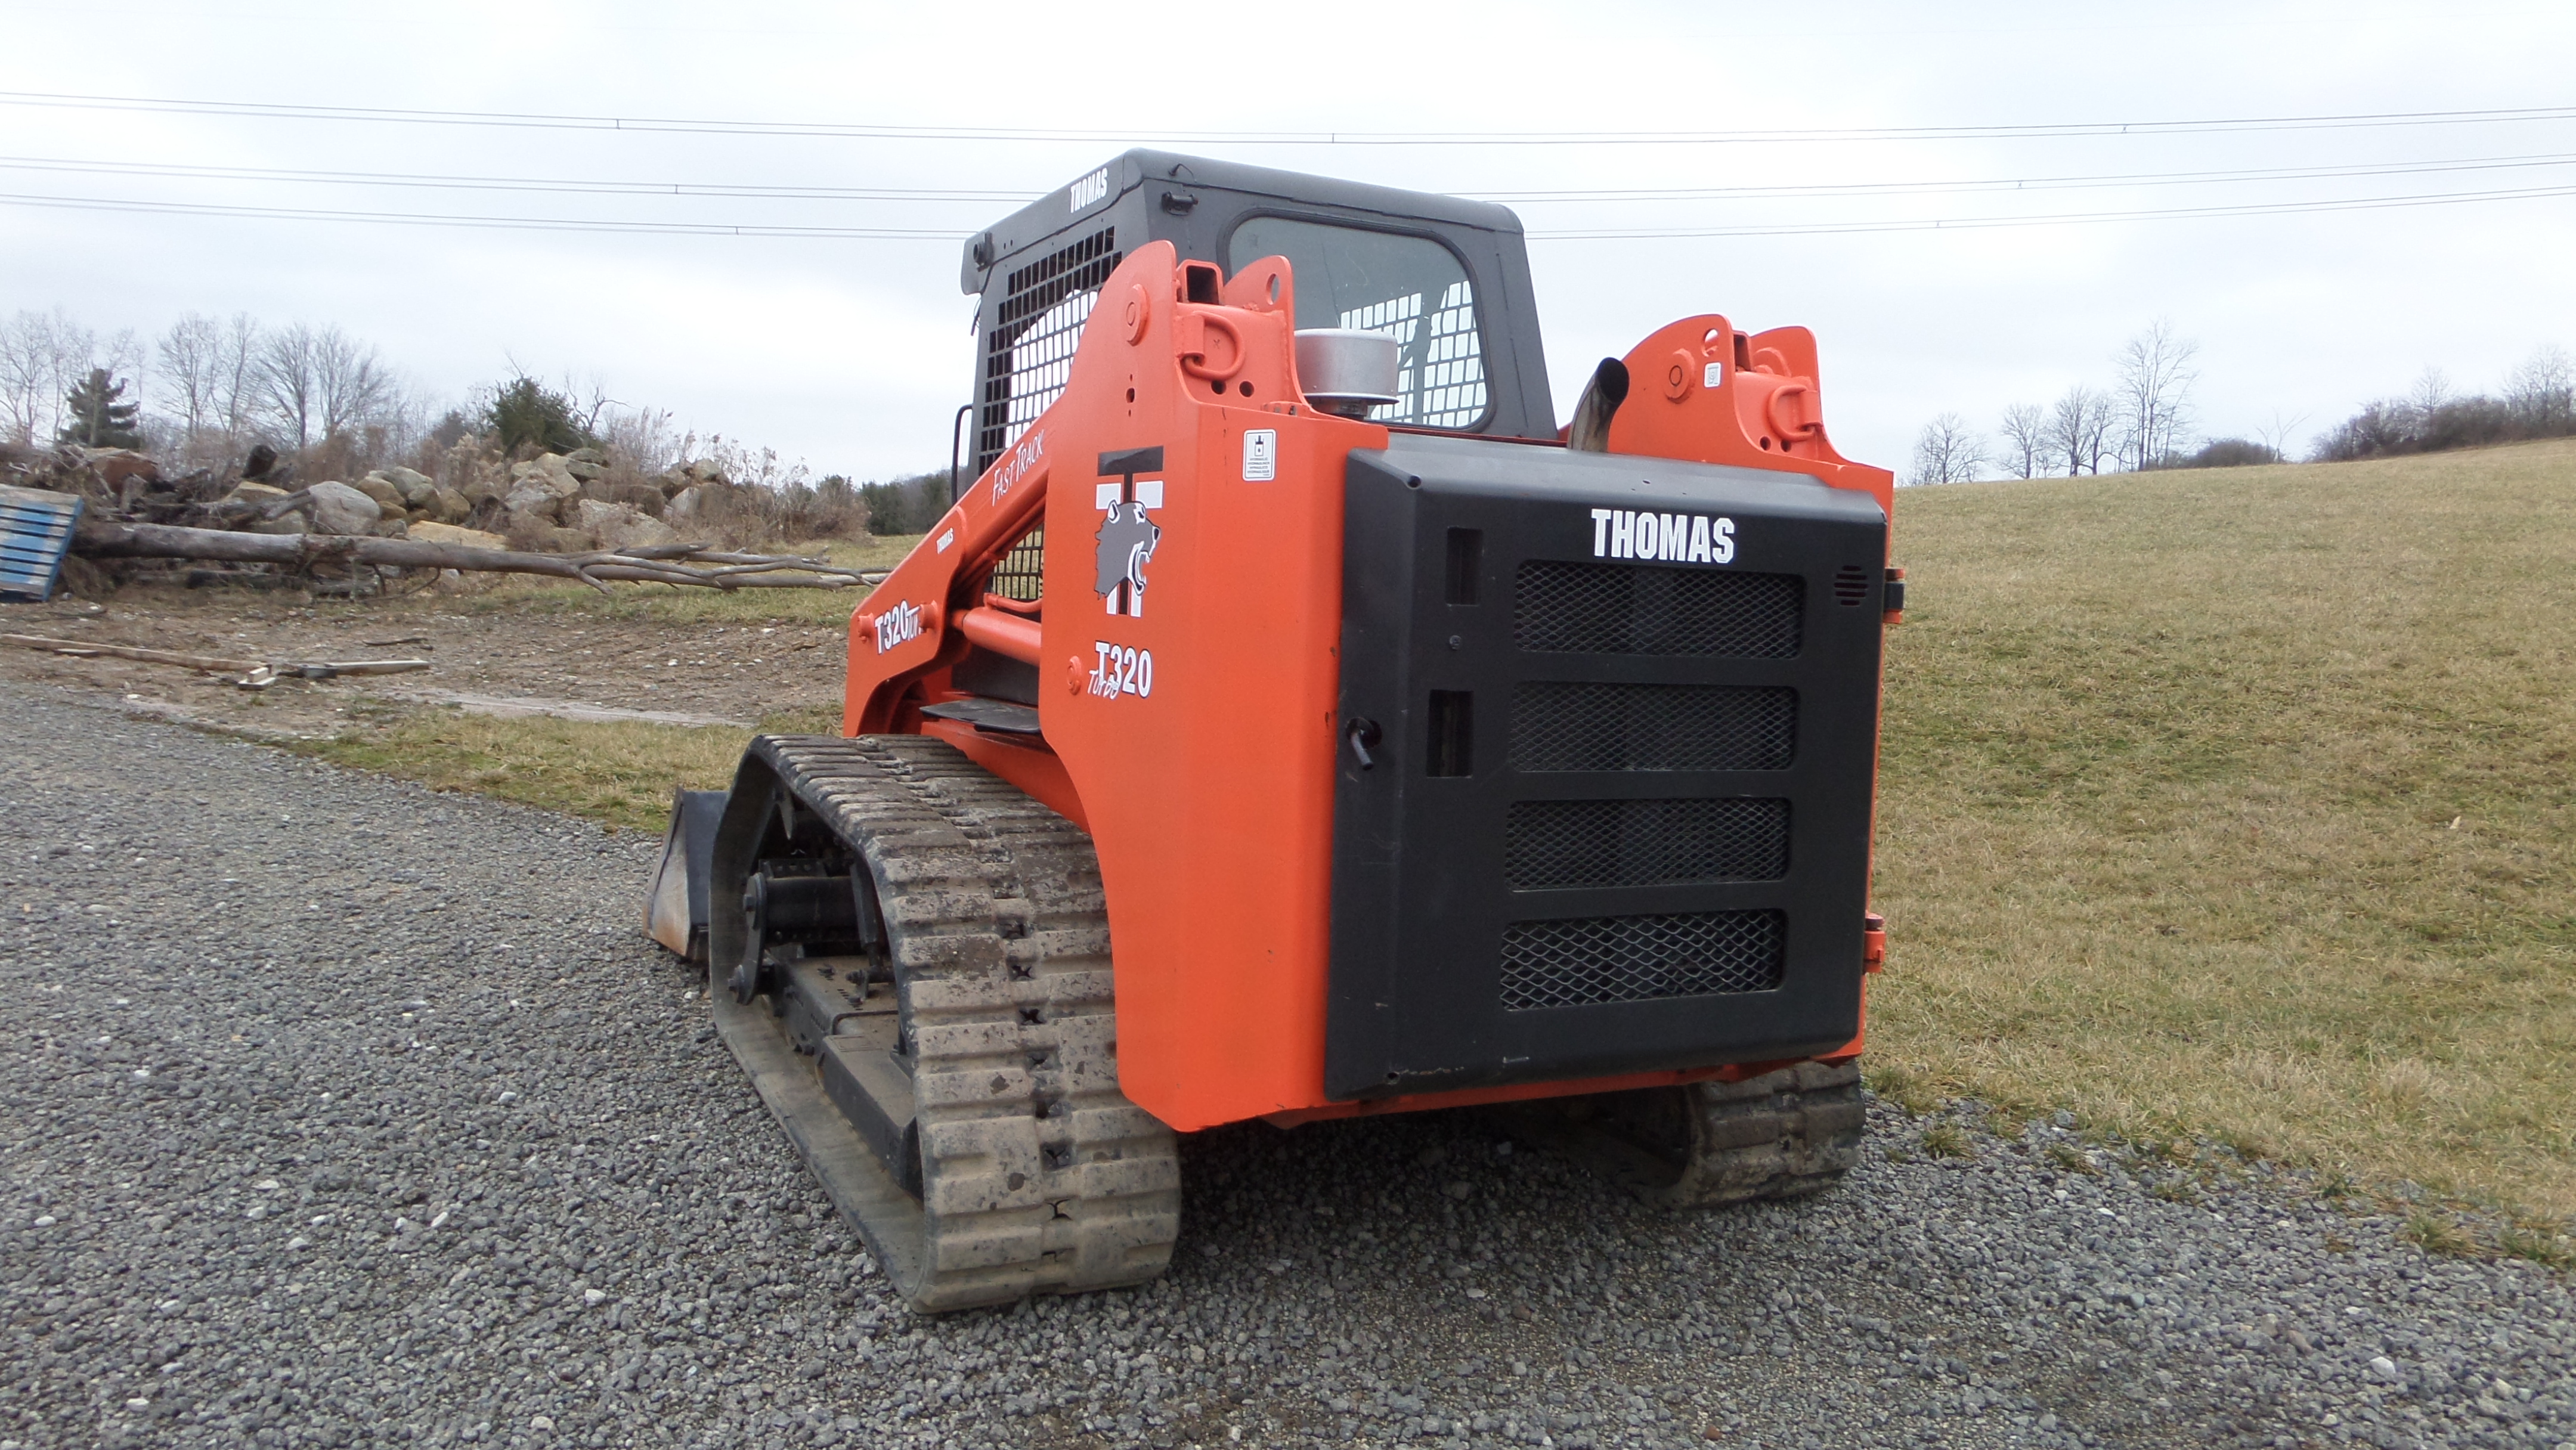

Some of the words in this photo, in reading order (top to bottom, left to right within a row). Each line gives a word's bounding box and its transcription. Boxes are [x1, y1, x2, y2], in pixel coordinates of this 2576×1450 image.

[1070, 168, 1108, 213] THOMAS
[992, 460, 1015, 507] FAST
[1016, 429, 1044, 482] TRACK
[1590, 508, 1735, 563] THOMAS
[874, 600, 909, 654] T320
[906, 605, 922, 642] Tur
[1087, 669, 1120, 700] Turbo
[1095, 640, 1152, 698] T320
